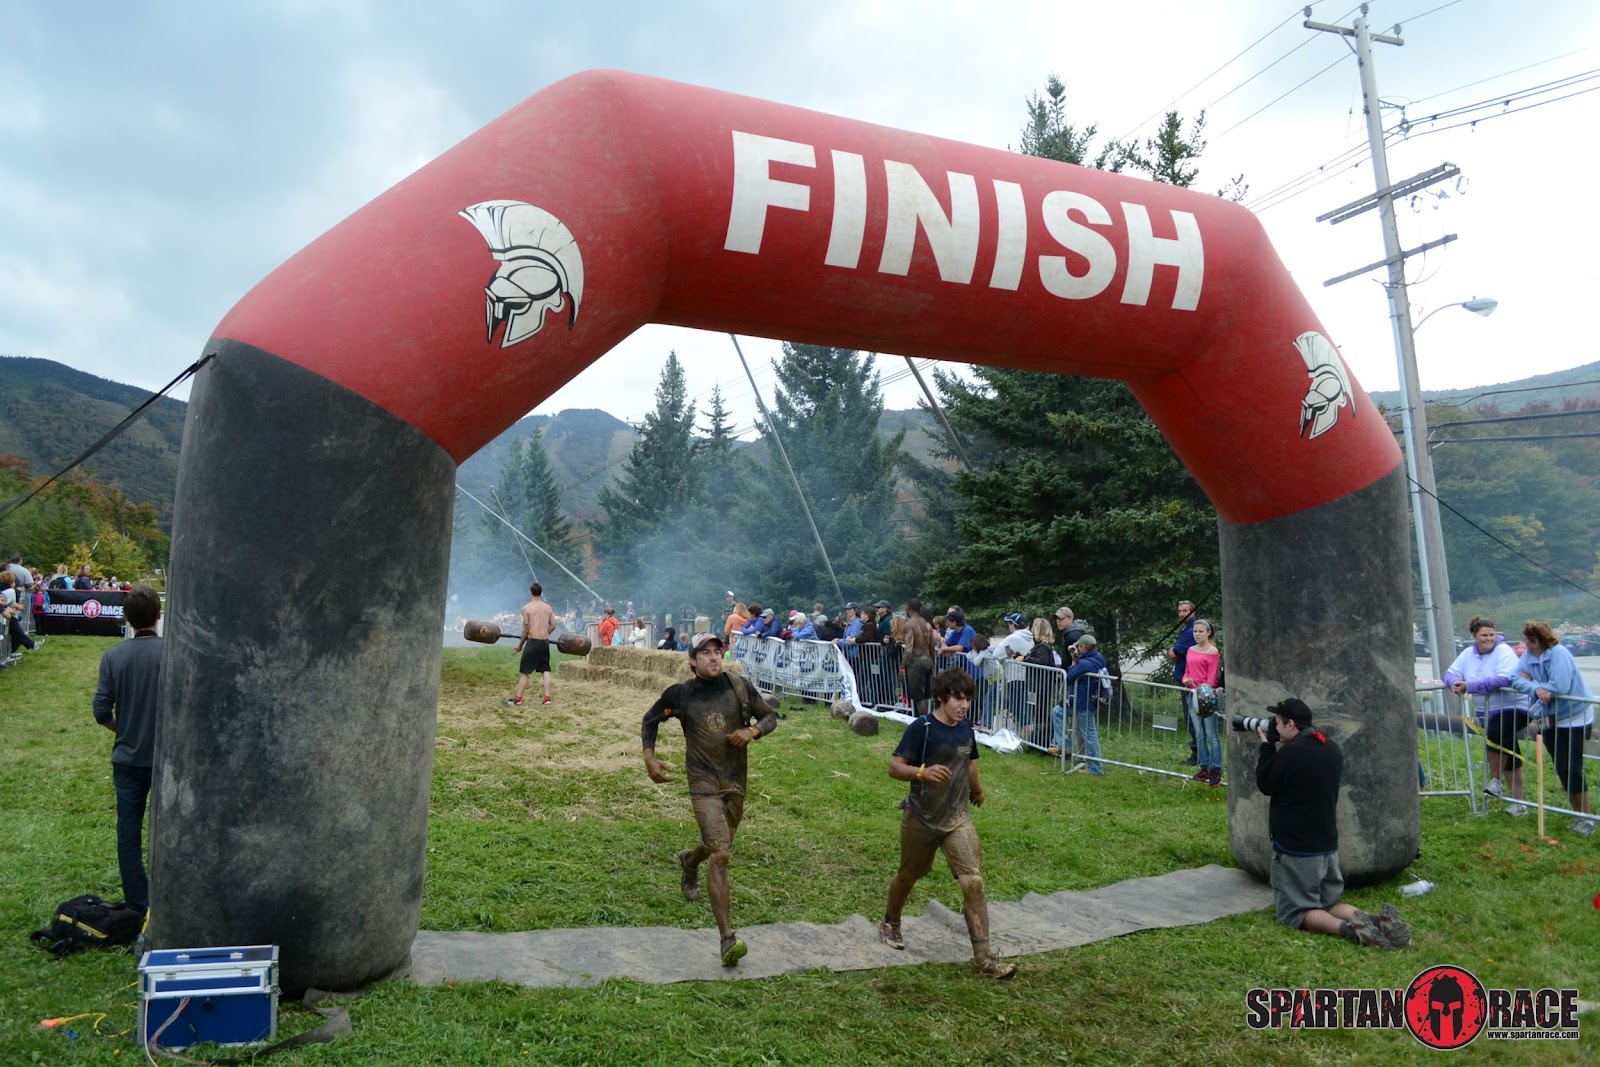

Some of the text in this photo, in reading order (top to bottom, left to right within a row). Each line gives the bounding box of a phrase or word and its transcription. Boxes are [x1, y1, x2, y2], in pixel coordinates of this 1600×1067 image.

[724, 130, 1204, 310] FINISH
[47, 604, 124, 615] SPARTAN RACE
